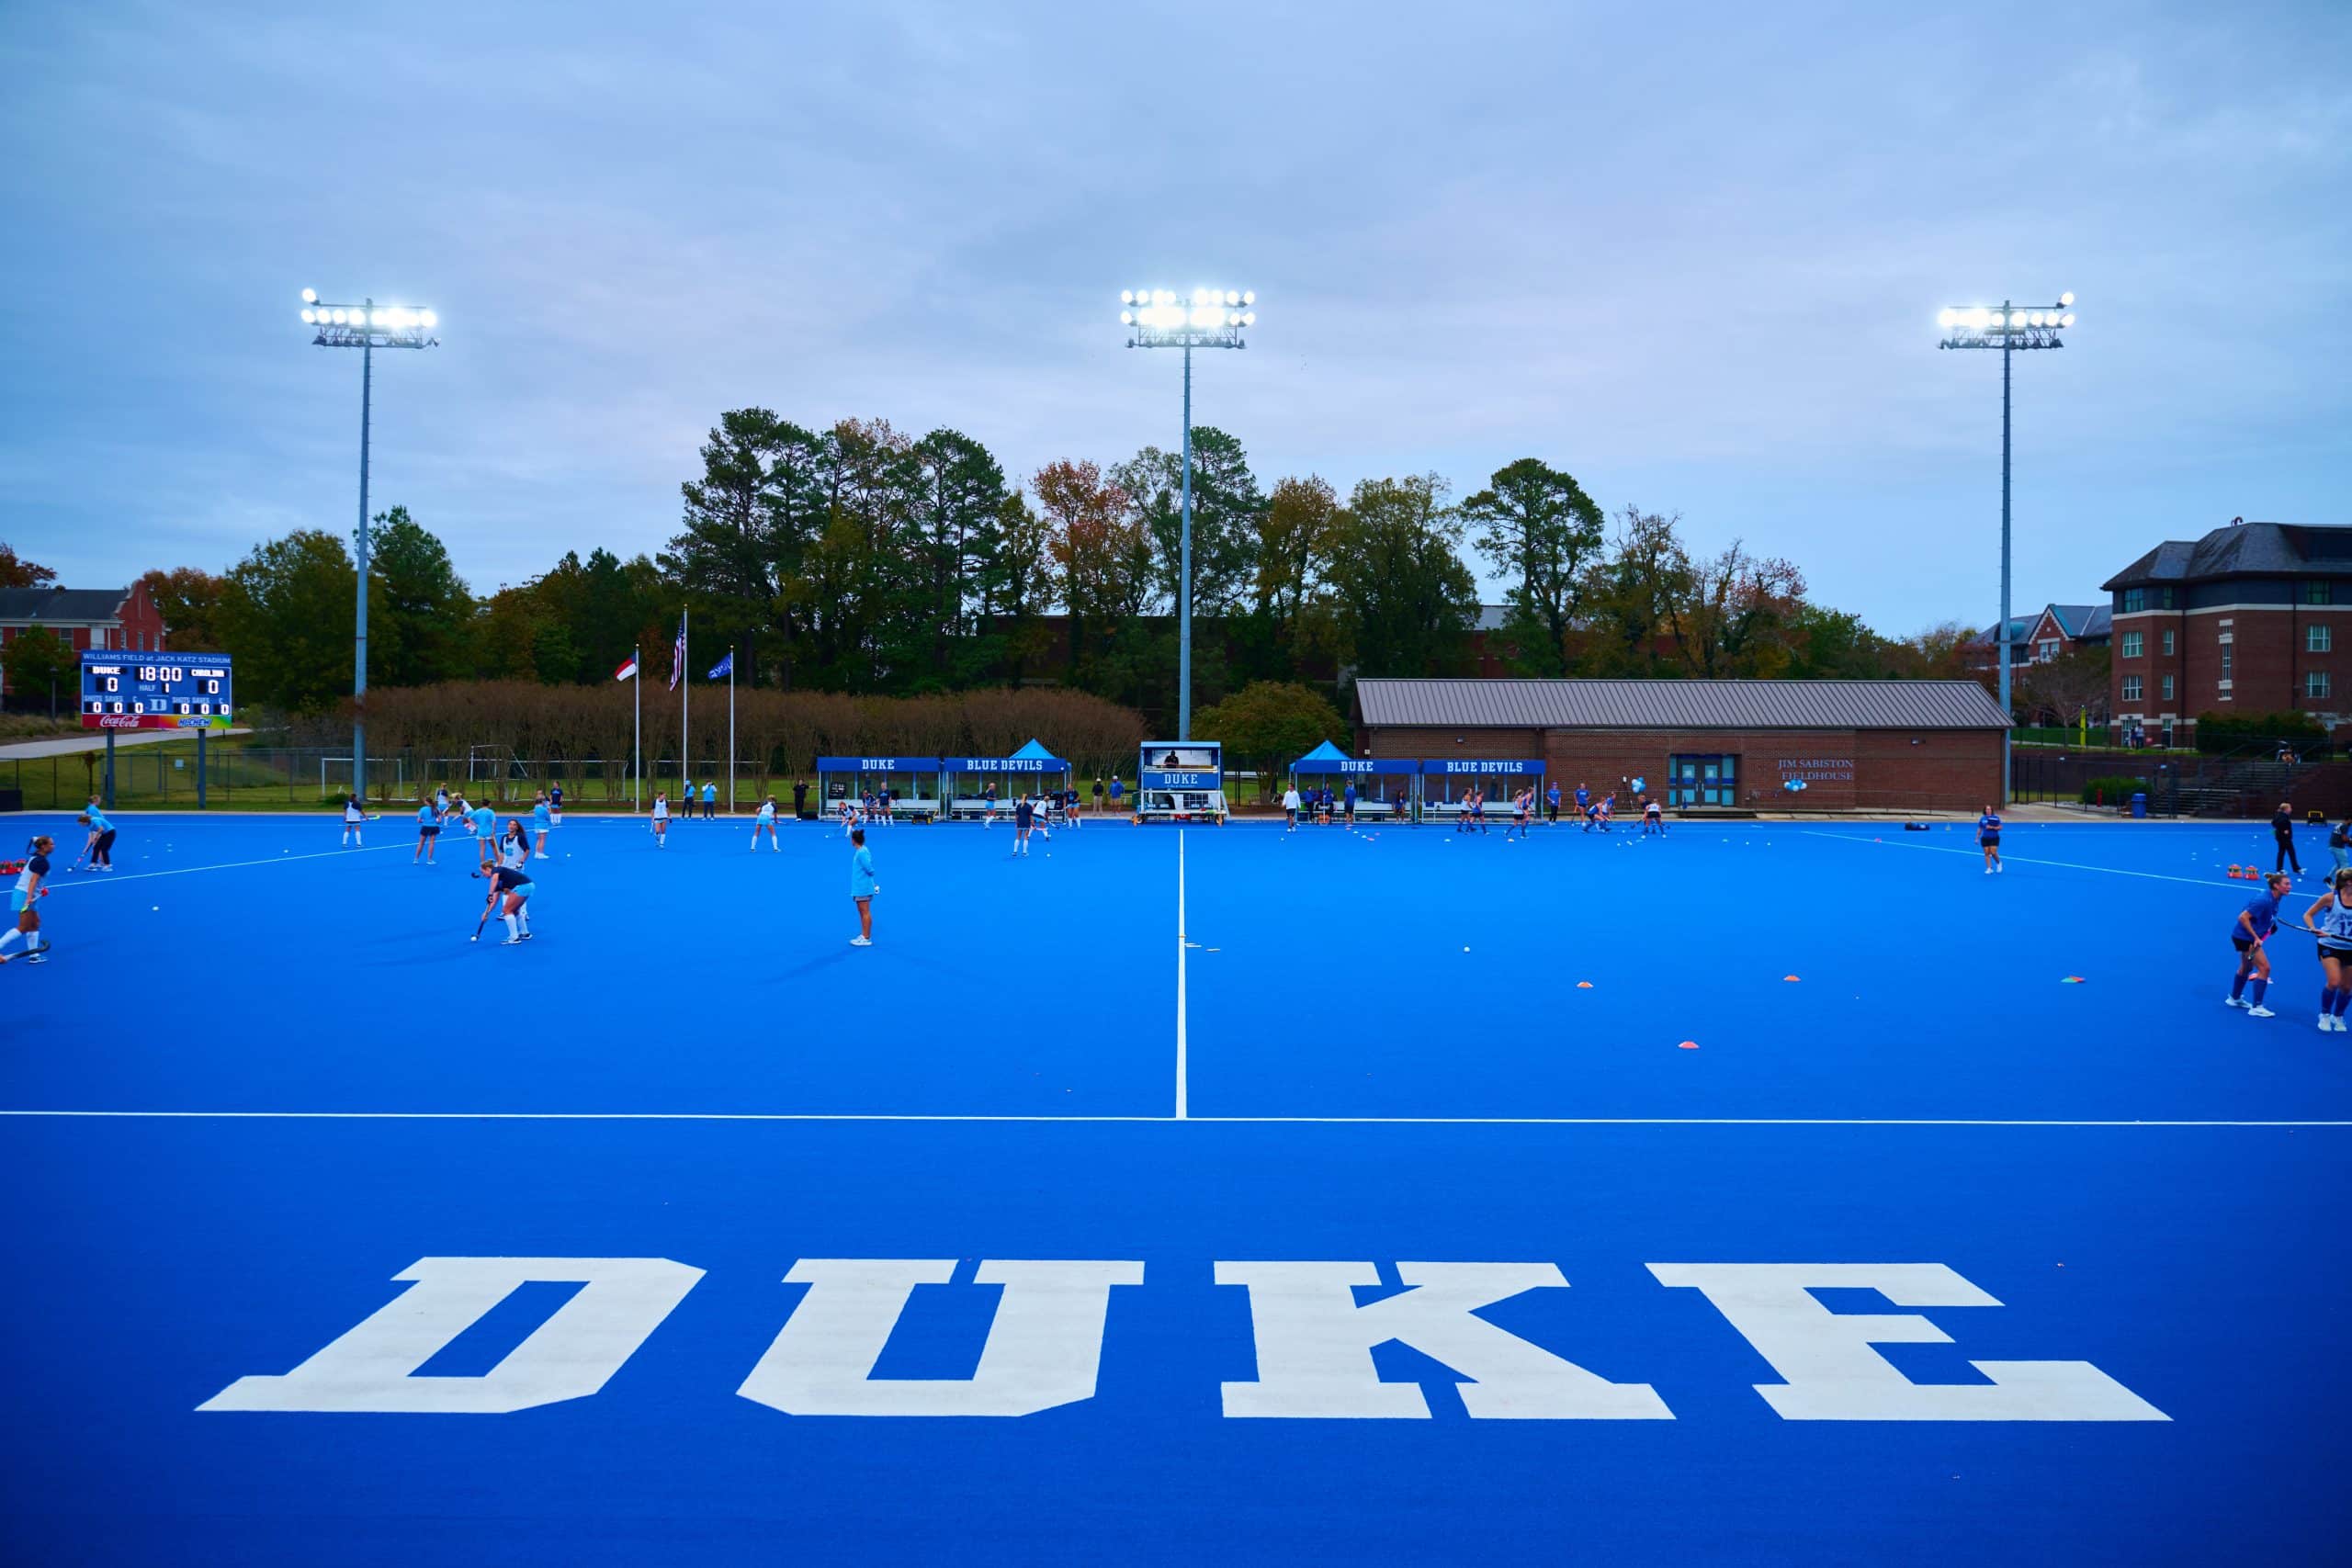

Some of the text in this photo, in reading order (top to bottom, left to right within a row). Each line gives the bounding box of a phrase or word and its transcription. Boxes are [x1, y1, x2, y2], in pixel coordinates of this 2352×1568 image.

[93, 666, 120, 674] DUKE
[139, 667, 182, 682] 18:00
[107, 677, 118, 692] 0
[165, 682, 170, 693] 1
[208, 680, 219, 694] 0
[93, 701, 143, 714] 0 0 0
[181, 703, 229, 715] 0 0 0
[862, 759, 895, 770] DUKE
[967, 760, 1043, 771] BLUE DEVILS
[1340, 761, 1374, 772] DUKE
[1447, 761, 1522, 773] BLUE DEVILS
[1778, 759, 1853, 770] JIM SABISTON
[1164, 773, 1199, 784] DUKE
[1781, 771, 1853, 780] FIELDHOUSE
[193, 1256, 2174, 1423] DUKE
